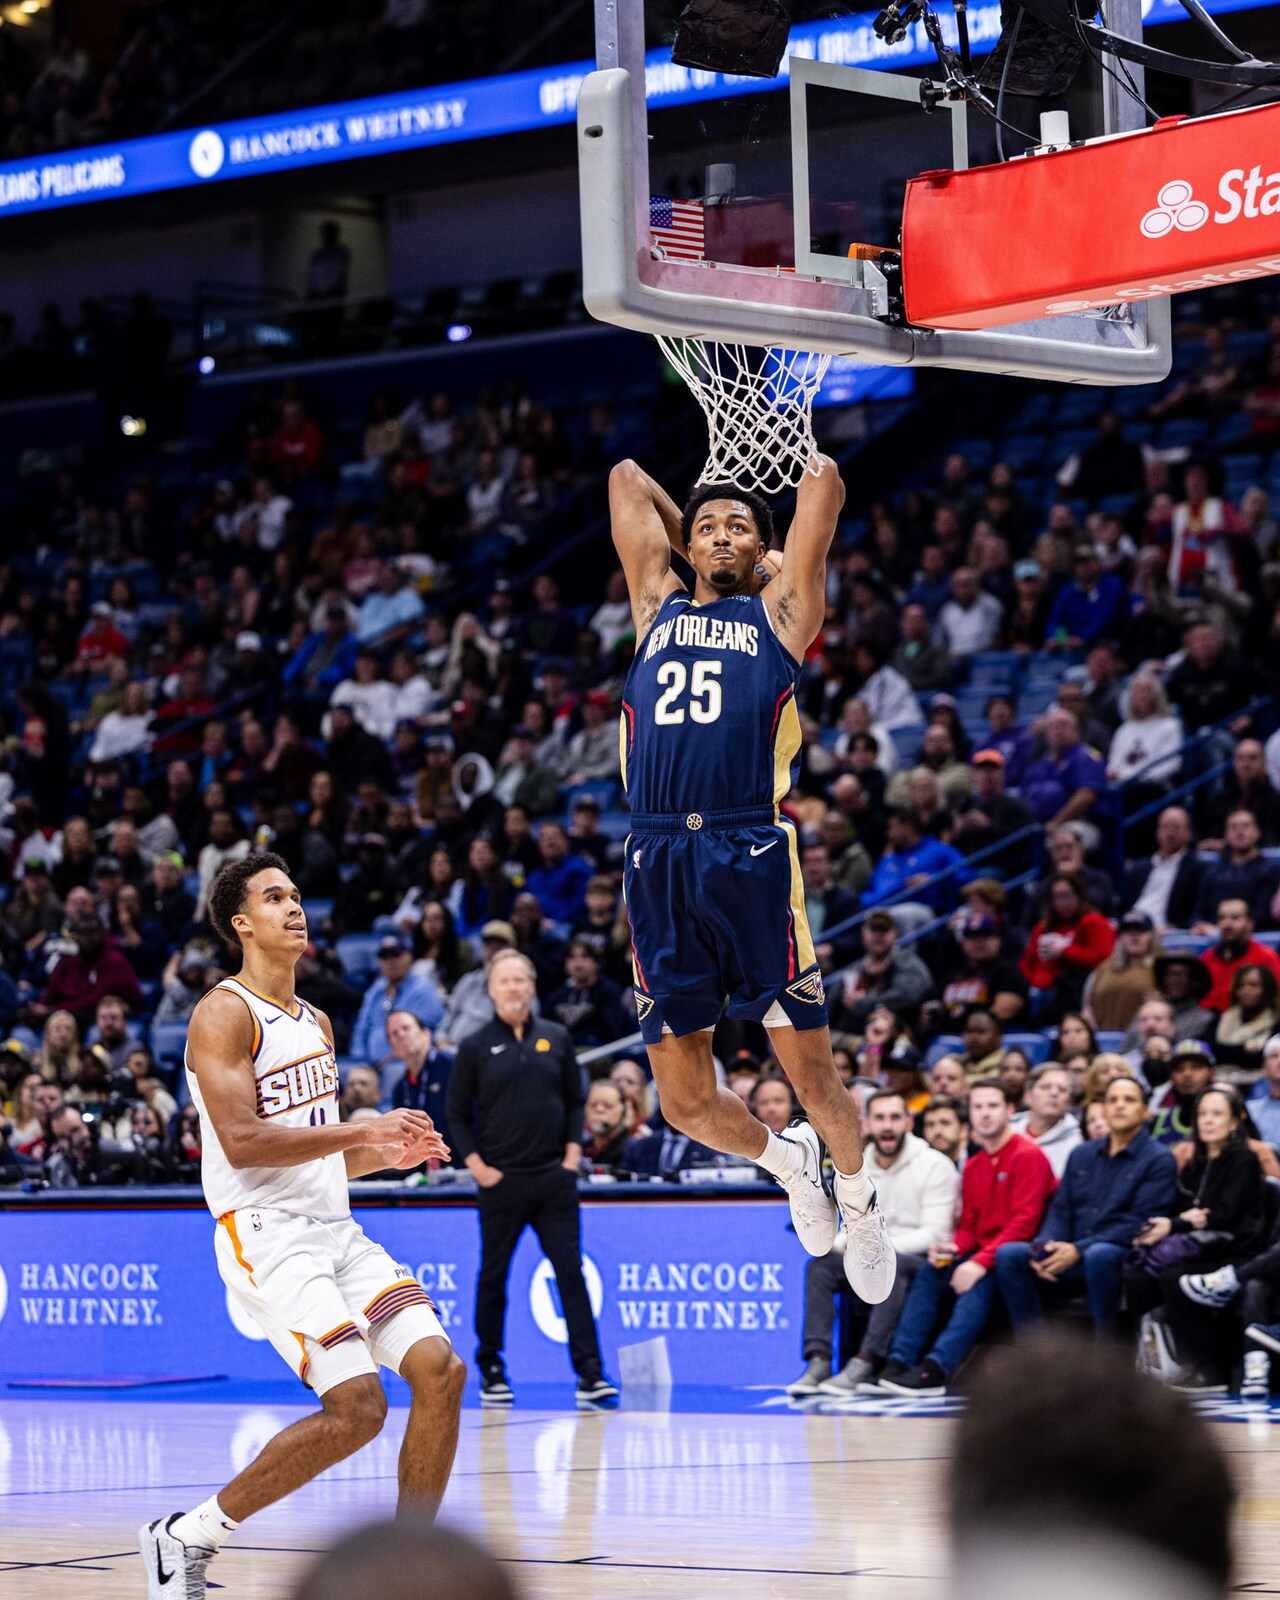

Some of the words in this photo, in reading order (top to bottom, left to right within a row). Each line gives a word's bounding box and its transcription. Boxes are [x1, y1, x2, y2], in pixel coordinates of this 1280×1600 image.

[229, 119, 341, 165] HANCOCK
[345, 97, 467, 142] WHITNEY
[41, 153, 125, 199] PELICANS
[643, 618, 676, 664] NEW
[675, 614, 759, 657] ORLEANS
[654, 660, 723, 726] 25
[260, 1052, 337, 1116] SUNS
[20, 1263, 160, 1291] HANCOCK
[617, 1262, 784, 1293] HANCOCK
